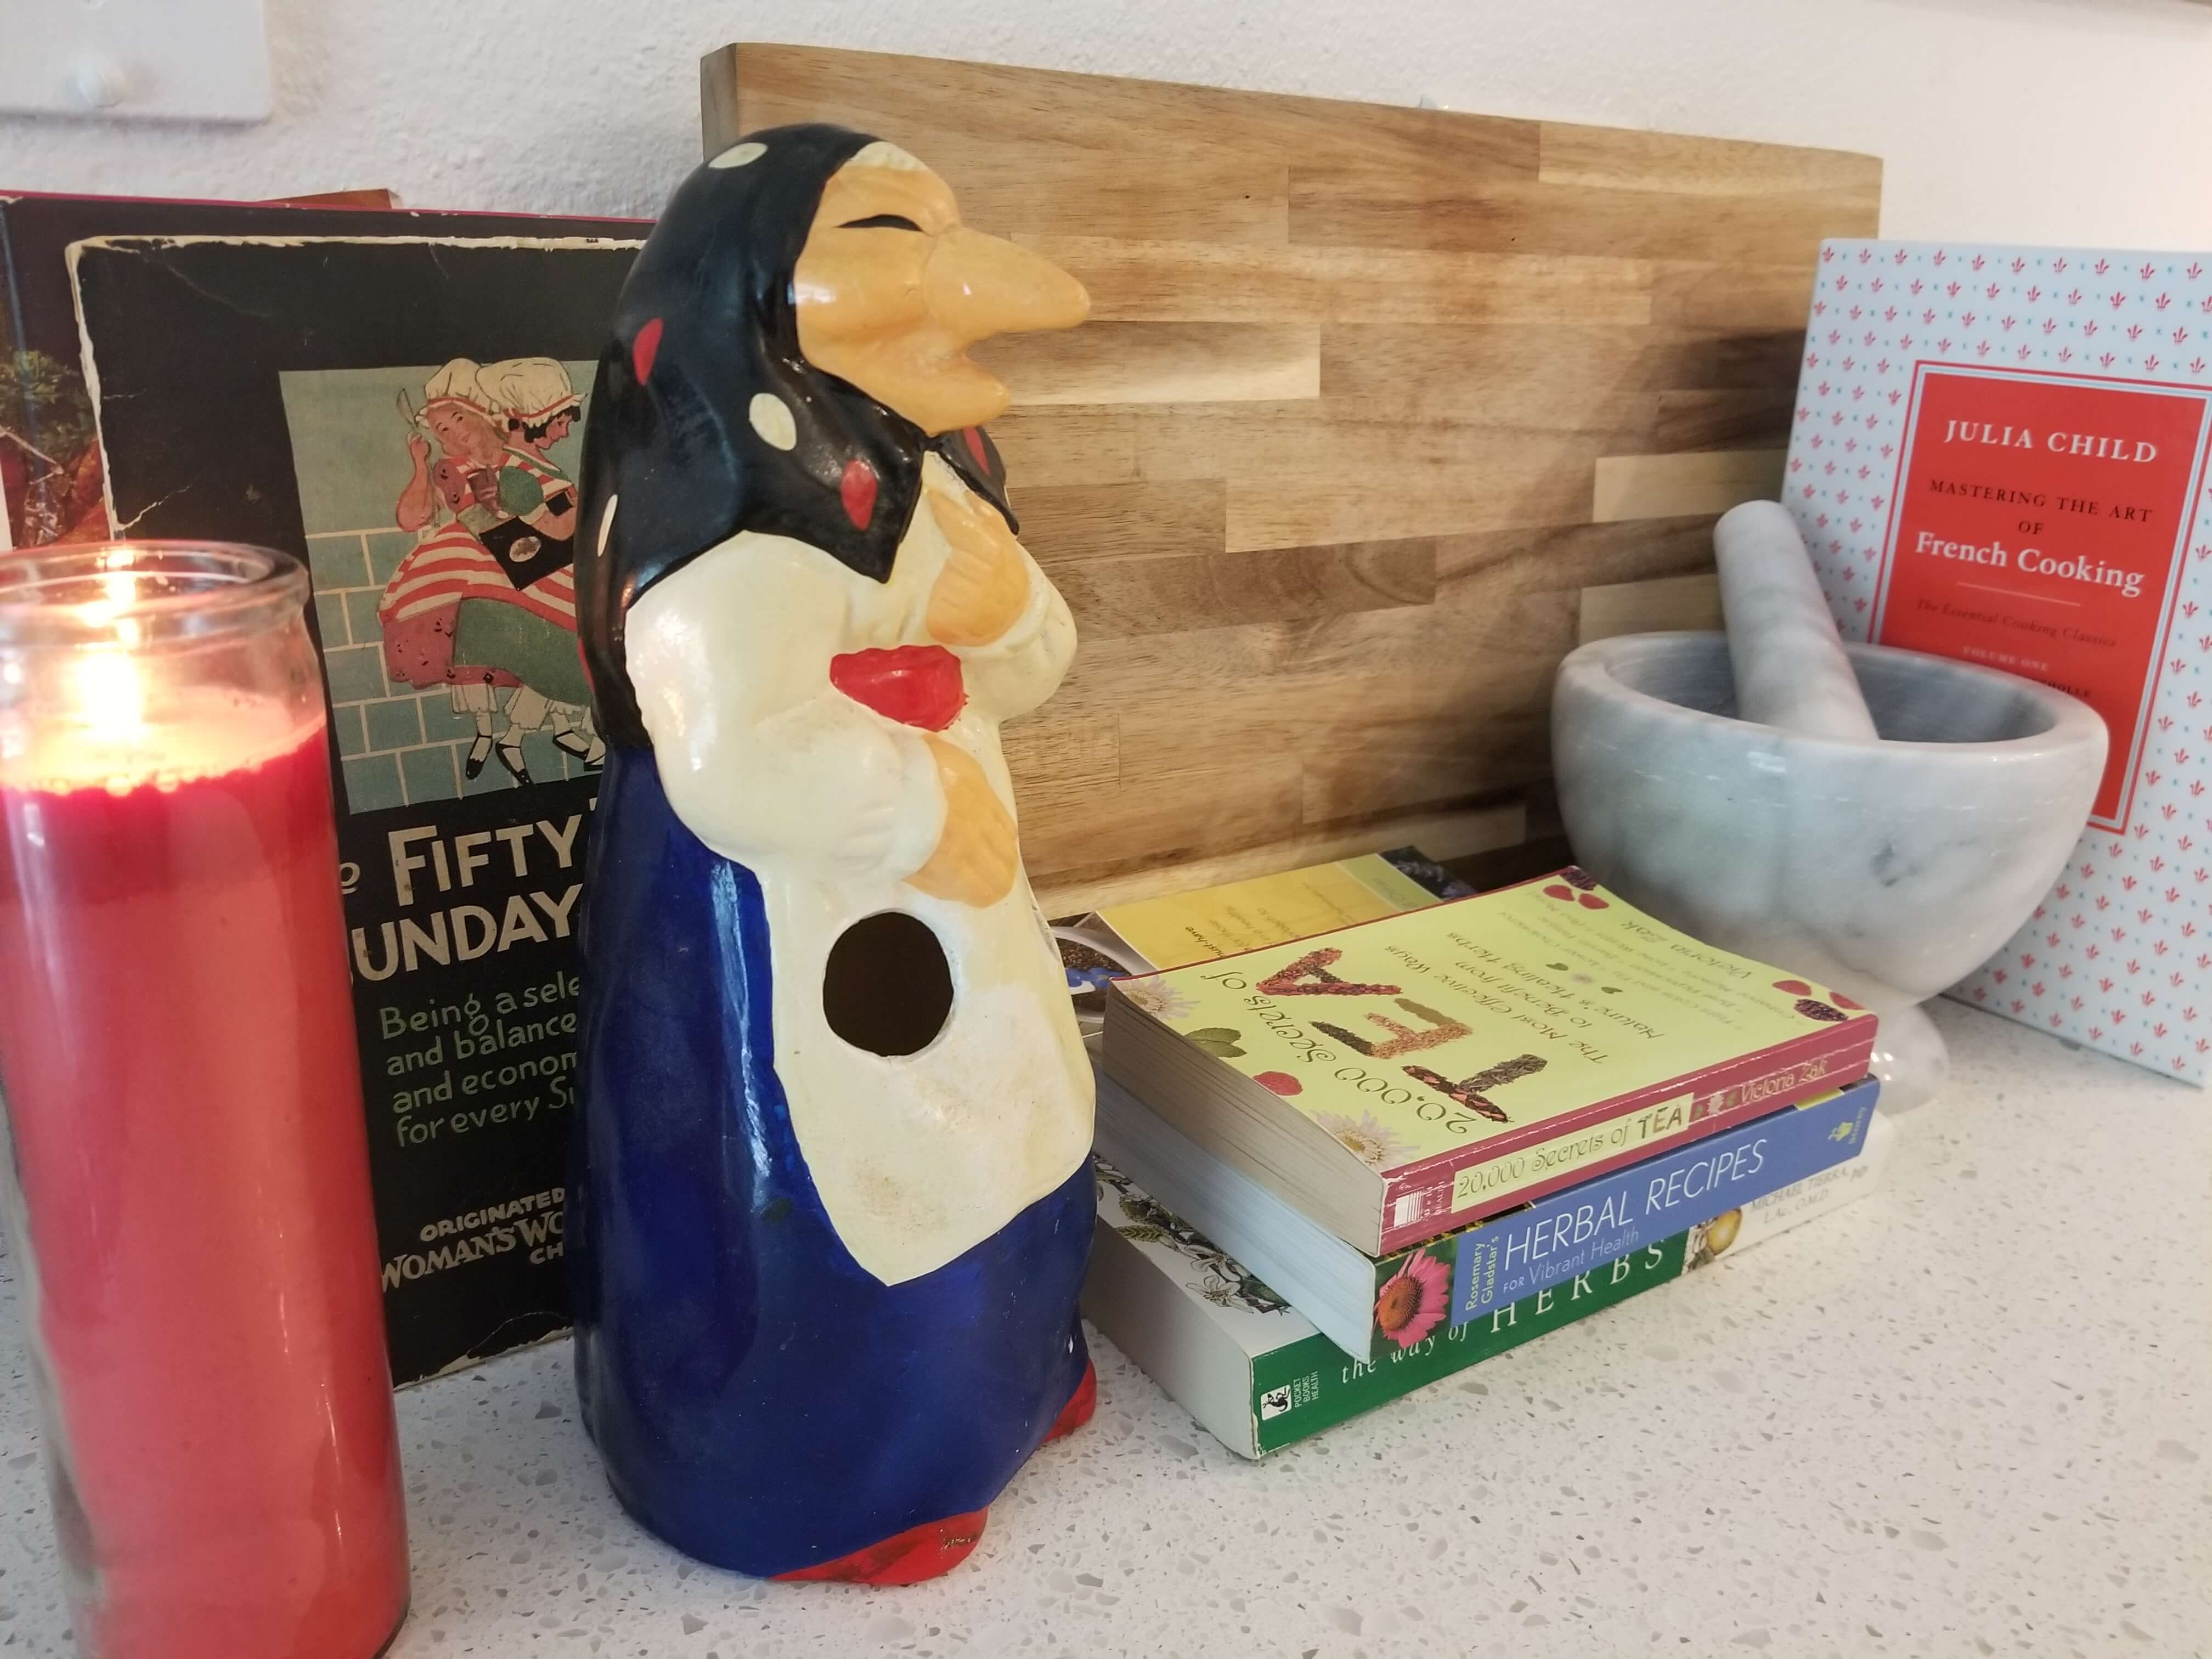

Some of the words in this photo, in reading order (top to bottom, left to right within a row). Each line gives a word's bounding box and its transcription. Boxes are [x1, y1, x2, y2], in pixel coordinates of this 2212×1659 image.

[1945, 420, 2033, 449] JULIA
[2047, 432, 2157, 462] CHILD
[1929, 479, 2046, 508] MASTERING
[2057, 496, 2099, 515] THE
[2109, 505, 2153, 523] ART
[2018, 520, 2044, 535] OF
[1915, 531, 2007, 567] French
[2017, 549, 2146, 598] Cooking
[1917, 599, 1938, 611] The
[1942, 605, 1999, 624] Essential
[2002, 615, 2057, 638] Cooking
[2063, 627, 2118, 647] Classics
[1963, 645, 2017, 665] VOLUME
[2021, 659, 2050, 672] ONE
[387, 814, 582, 907] FIFTY
[350, 883, 583, 985] UNDAY
[1446, 932, 1502, 963] Herbs
[1620, 921, 1668, 944] Zak
[1200, 972, 1247, 990] of
[1384, 945, 1431, 974] Ways
[1455, 961, 1505, 984] from
[1501, 962, 1576, 1000] Healing
[1671, 944, 1752, 979] Victoria
[1434, 973, 1511, 1014] Effective
[1497, 983, 1570, 1017] Benefit
[380, 993, 489, 1040] Being
[495, 992, 517, 1014] a
[1244, 996, 1336, 1063] Secrets
[1255, 947, 1548, 1123] TEA
[1511, 1013, 1567, 1040] Most
[1570, 1017, 1593, 1029] to
[1579, 998, 1664, 1039] Nature's
[387, 1036, 443, 1076] and
[455, 1012, 576, 1059] balance
[1568, 1040, 1609, 1064] The
[393, 1070, 452, 1113] and
[1334, 1067, 1477, 1134] 20,000
[1741, 1074, 1795, 1102] Victoria
[1798, 1059, 1828, 1084] Zak
[397, 1116, 444, 1147] for
[451, 1096, 540, 1134] every
[1531, 1131, 1603, 1172] Secrets
[1610, 1118, 1632, 1147] of
[1637, 1102, 1683, 1139] TEA
[420, 1187, 565, 1242] ORIGINATED
[1504, 1190, 1634, 1271] HERBAL
[1645, 1138, 1768, 1216] RECIPES
[1465, 1242, 1486, 1312] Rosemary
[1481, 1235, 1499, 1305] Gladstar's
[1503, 1276, 1525, 1294] FOR
[1528, 1249, 1585, 1285] Vibrant
[1591, 1226, 1639, 1261] Health
[1342, 1356, 1378, 1385] the
[1390, 1335, 1436, 1364] way
[1490, 1238, 1664, 1334] HERBS
[1294, 1377, 1303, 1409] POCKET
[1301, 1375, 1311, 1403] BOOKS
[1311, 1370, 1319, 1401] HEALTH
